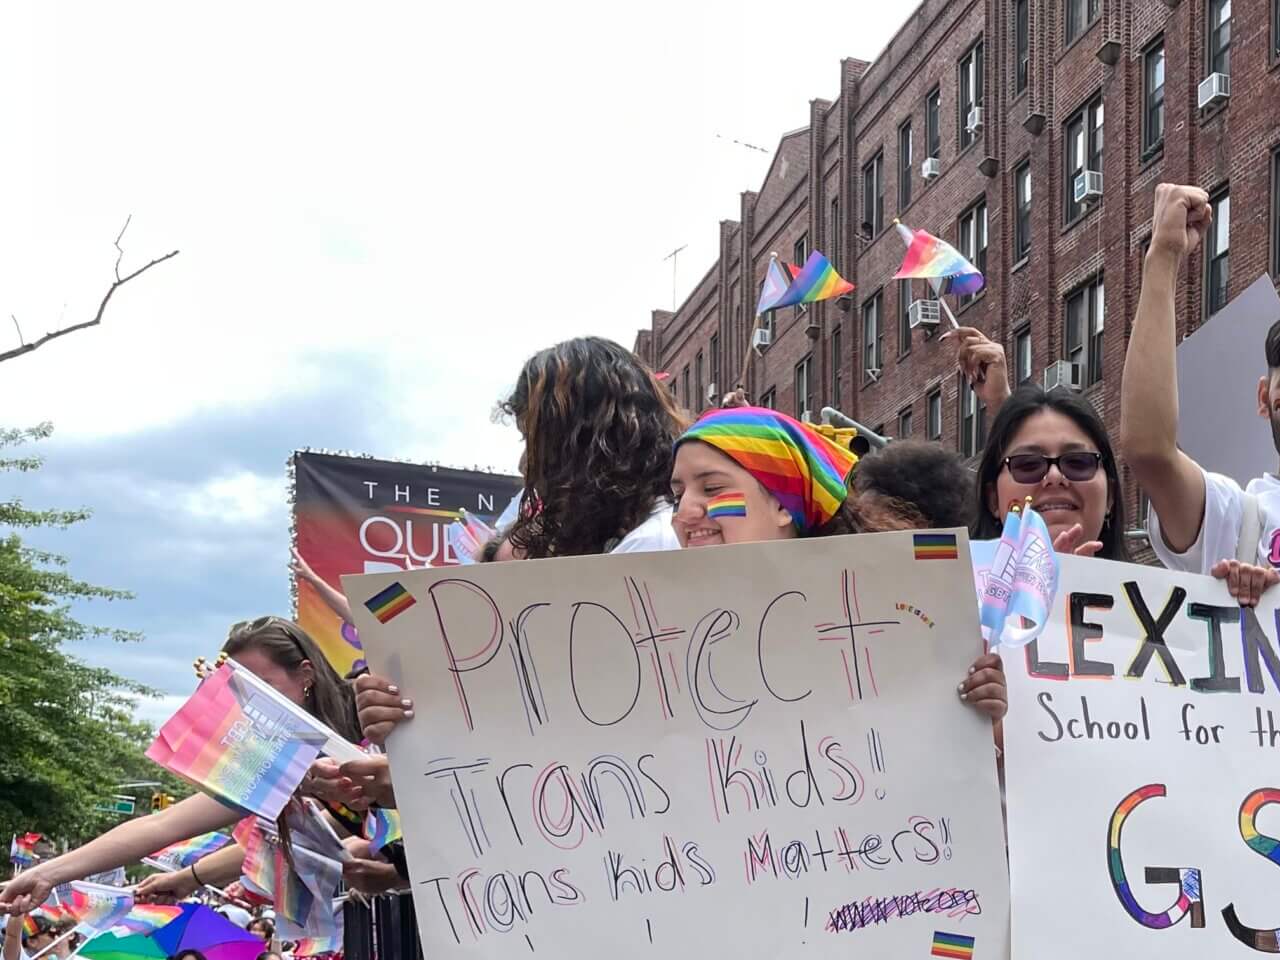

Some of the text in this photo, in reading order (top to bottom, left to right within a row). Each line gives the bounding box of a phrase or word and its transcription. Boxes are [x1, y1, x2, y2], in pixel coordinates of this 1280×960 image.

[363, 481, 440, 506] THE
[428, 569, 900, 735] Protect
[1037, 691, 1151, 743] School
[1178, 702, 1225, 745] for
[424, 753, 671, 857] Trans
[420, 867, 586, 945] Trans
